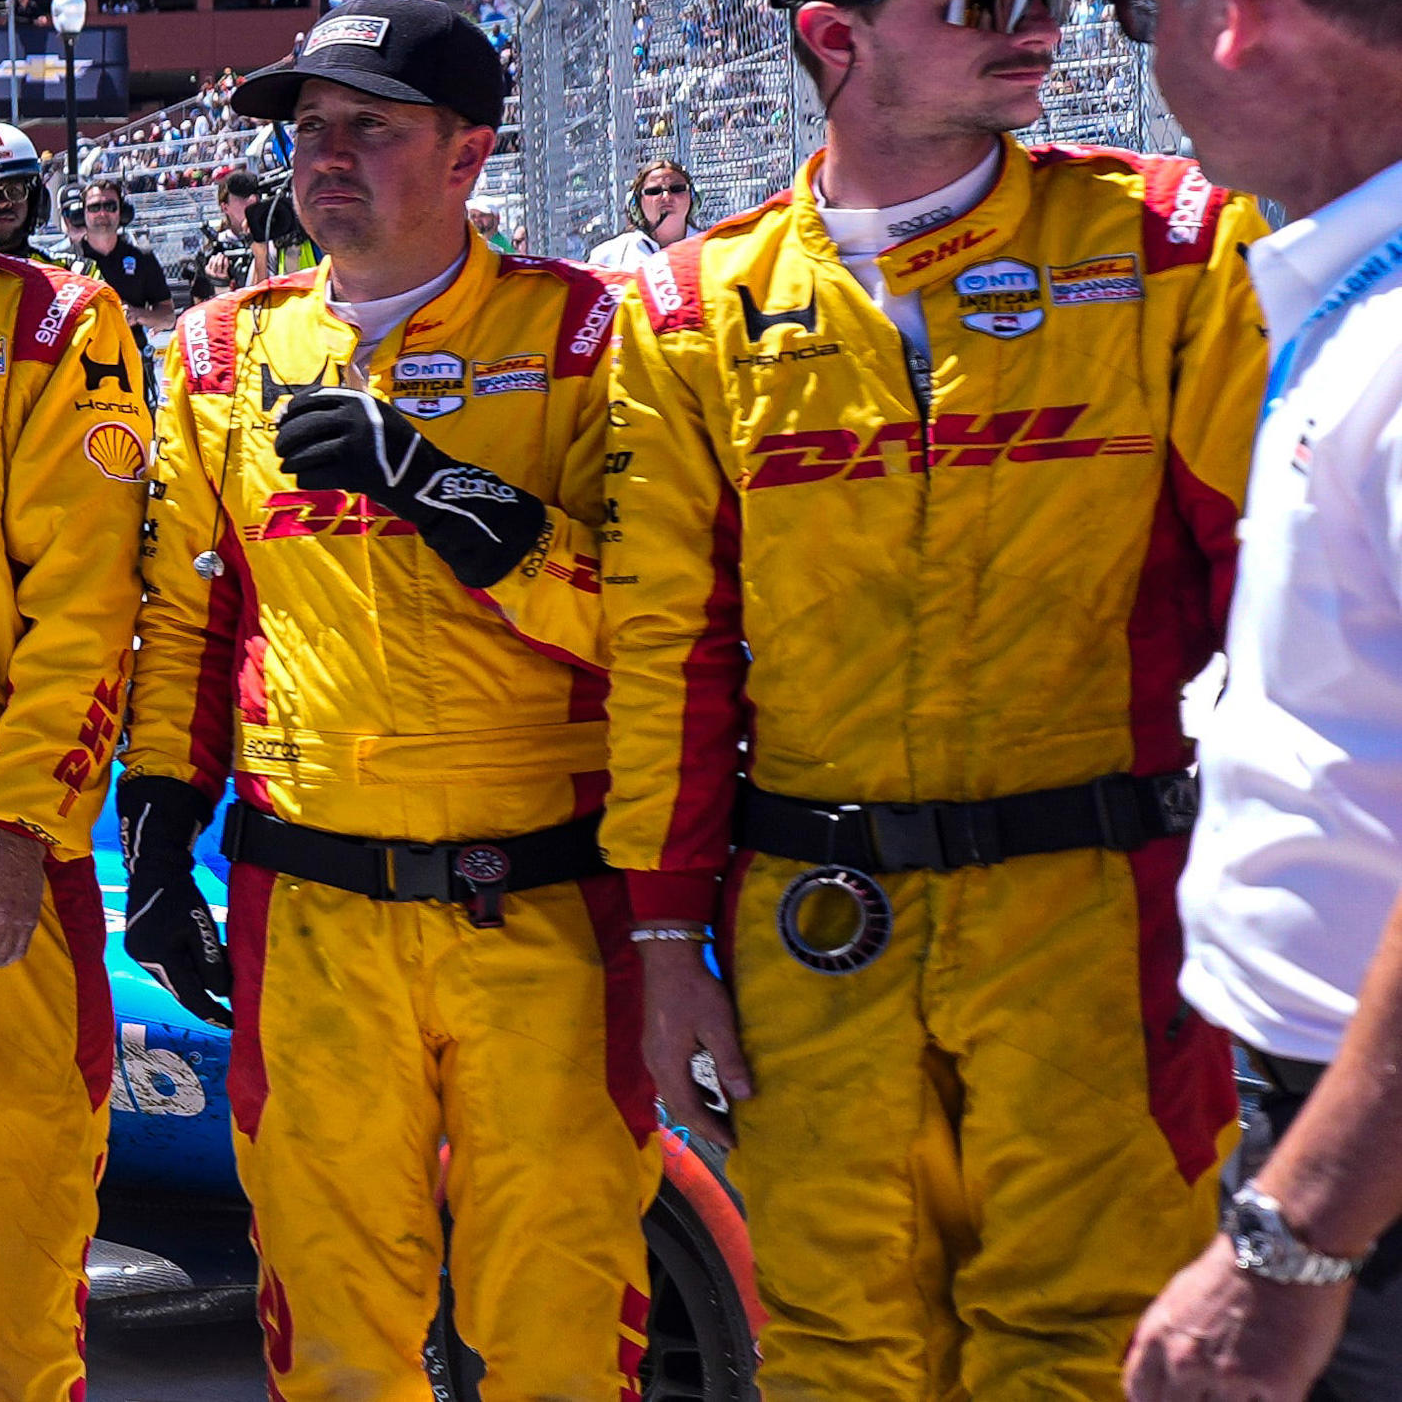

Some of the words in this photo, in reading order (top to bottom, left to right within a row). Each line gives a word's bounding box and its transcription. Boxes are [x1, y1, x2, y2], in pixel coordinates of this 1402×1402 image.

[989, 272, 1030, 286] NTT
[35, 283, 86, 346] sparco
[570, 283, 625, 357] sparco
[421, 363, 456, 375] NTT
[734, 343, 840, 368] Honda
[748, 403, 1104, 490] DHL
[441, 473, 519, 503] sparco
